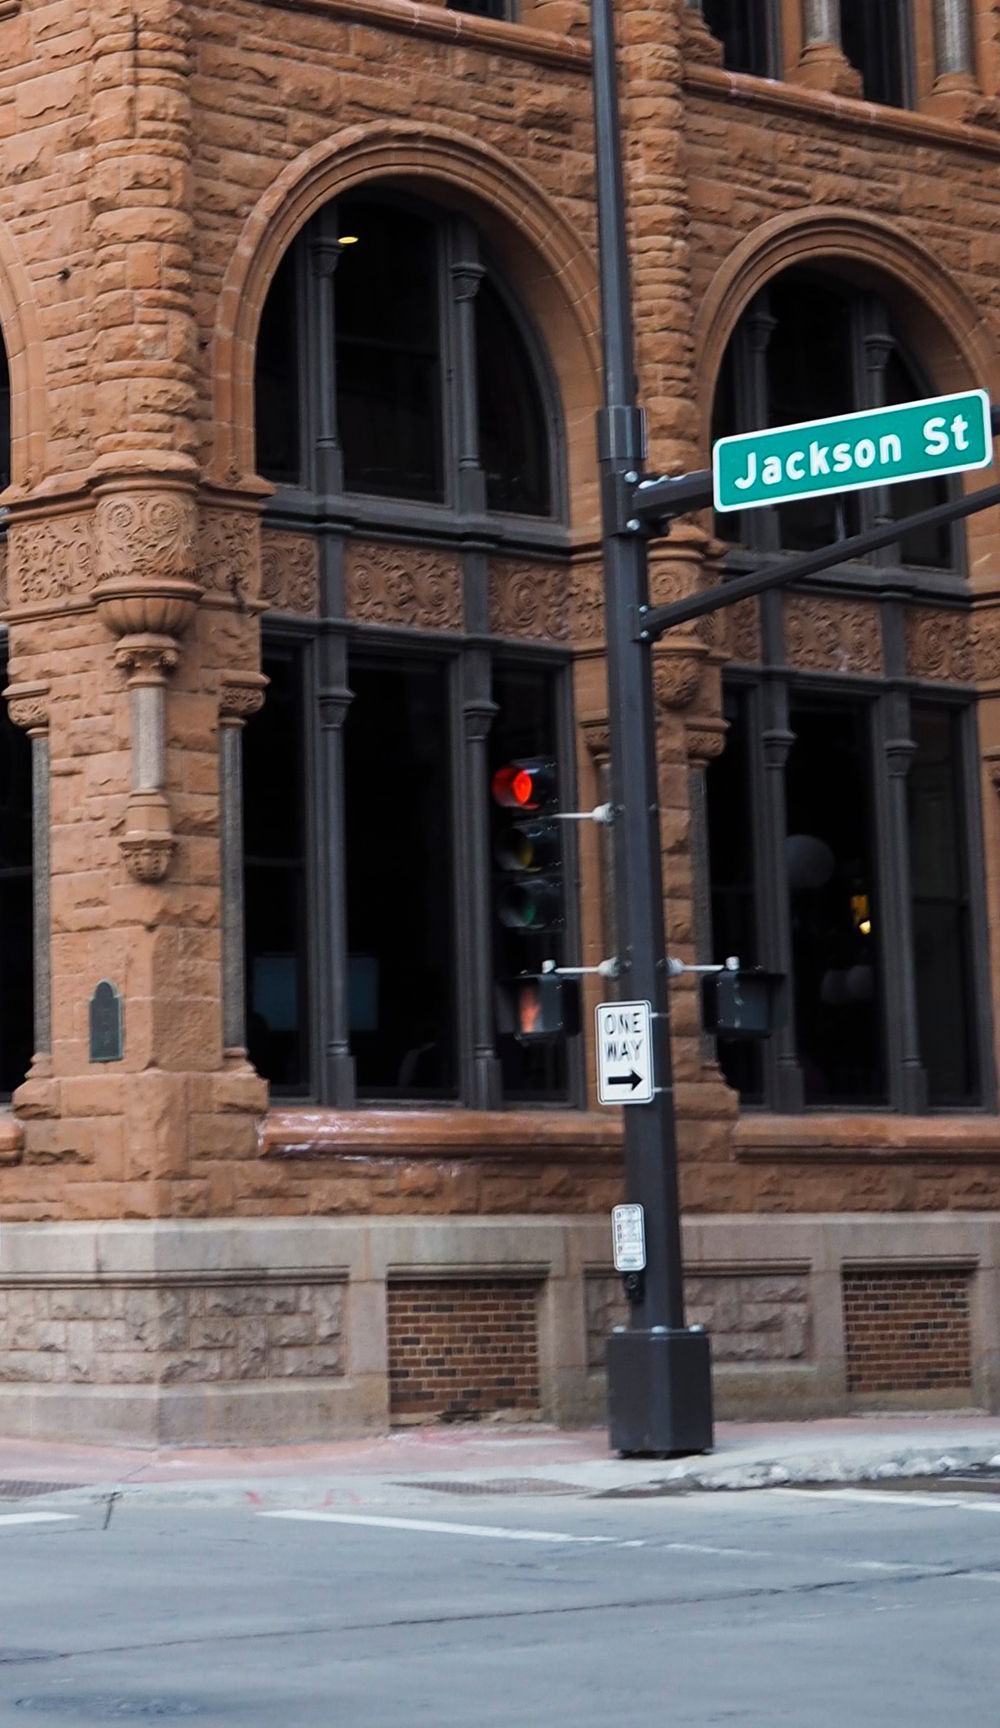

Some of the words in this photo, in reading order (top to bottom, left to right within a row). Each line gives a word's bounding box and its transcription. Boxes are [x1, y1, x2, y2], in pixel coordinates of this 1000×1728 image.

[734, 434, 902, 489] Jackson
[922, 413, 969, 456] St
[604, 1012, 642, 1035] ONE
[605, 1040, 643, 1062] WAY
